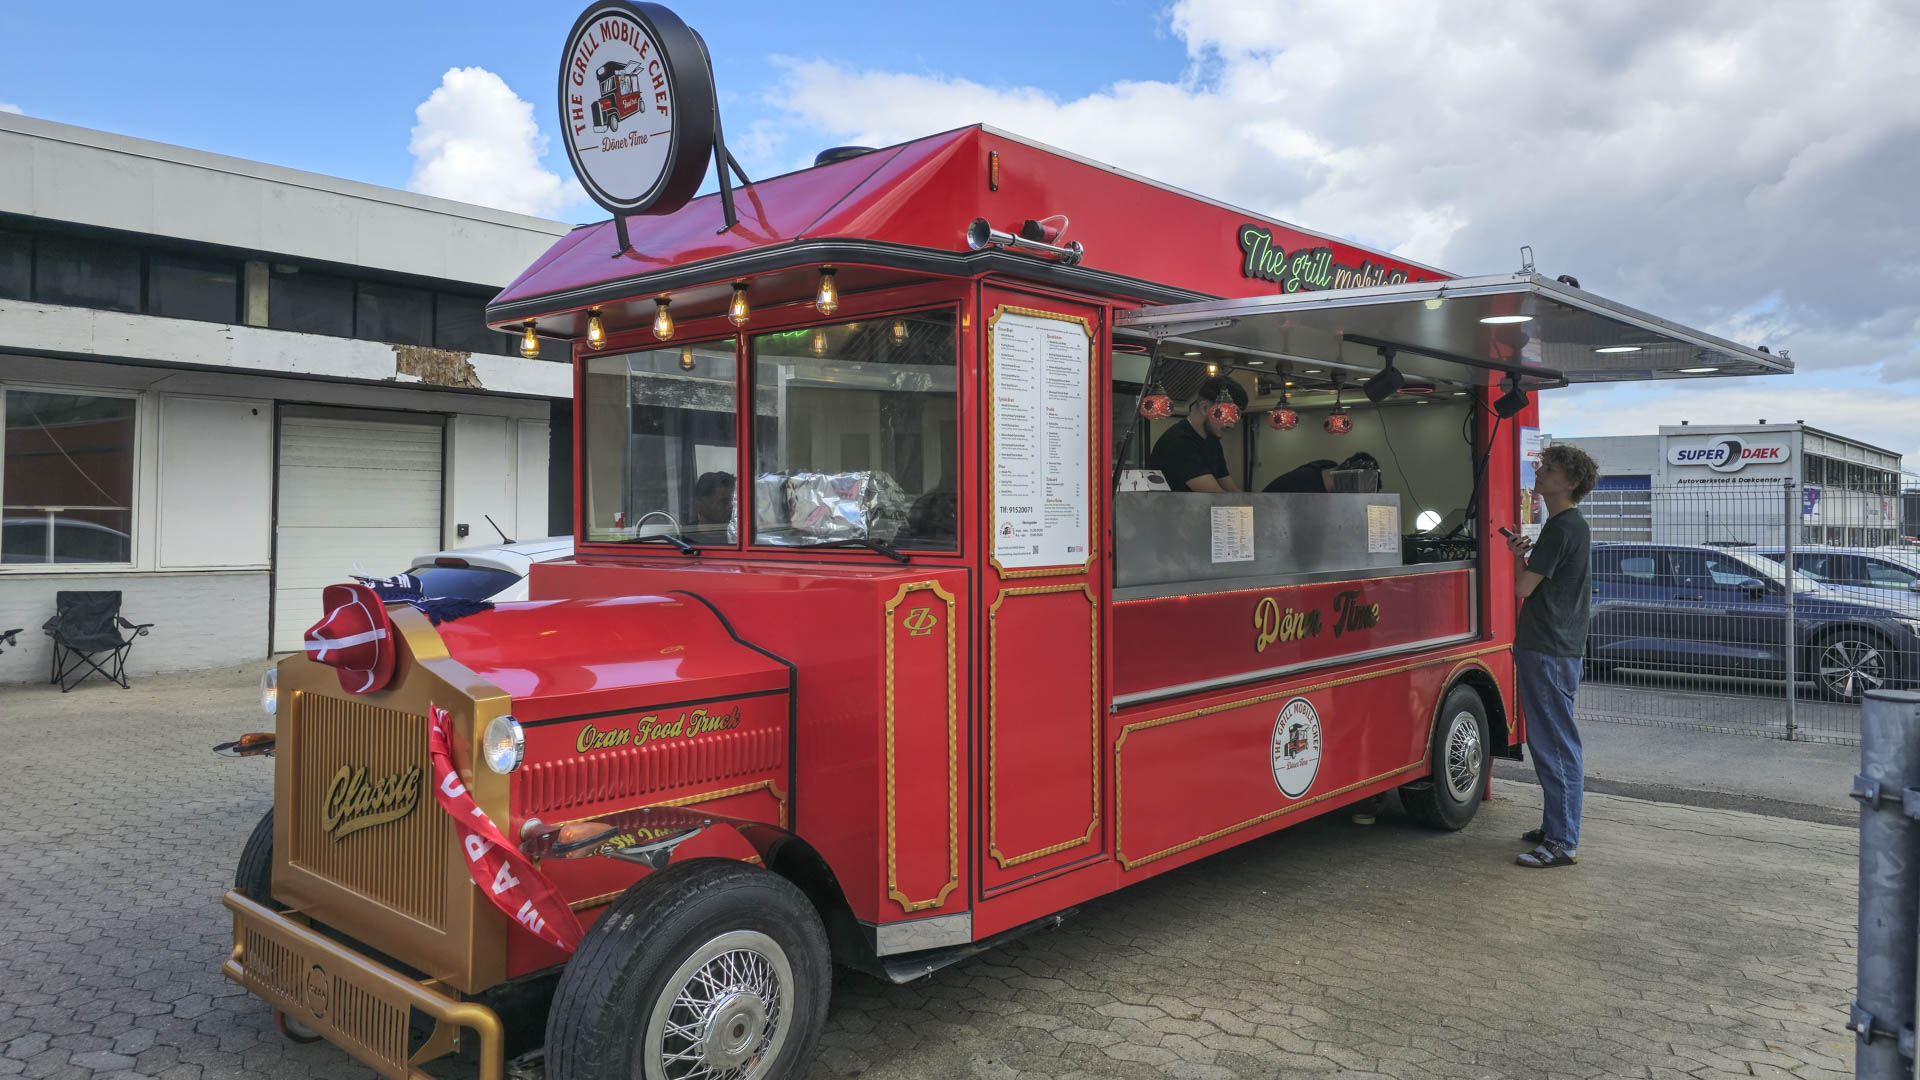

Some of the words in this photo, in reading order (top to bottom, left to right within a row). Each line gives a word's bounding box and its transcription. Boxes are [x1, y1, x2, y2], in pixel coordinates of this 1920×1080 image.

[600, 19, 650, 60] MOBILE
[573, 33, 599, 87] GRILL
[648, 60, 668, 117] CHEF
[571, 94, 587, 136] THE
[602, 137, 628, 152] Döner
[629, 130, 649, 147] Time
[1244, 230, 1287, 275] The
[1287, 253, 1333, 292] grill
[1677, 449, 1725, 461] SUPER
[1008, 506, 1033, 514] 91520071
[1254, 597, 1323, 653] Döner
[1333, 589, 1380, 639] Time
[1277, 708, 1293, 736] GRILL
[1293, 703, 1315, 722] MOBILE
[576, 723, 631, 753] Ozan
[633, 713, 686, 746] Food
[1274, 739, 1282, 762] THE
[1311, 724, 1319, 752] CHEF
[322, 764, 421, 838] Classic
